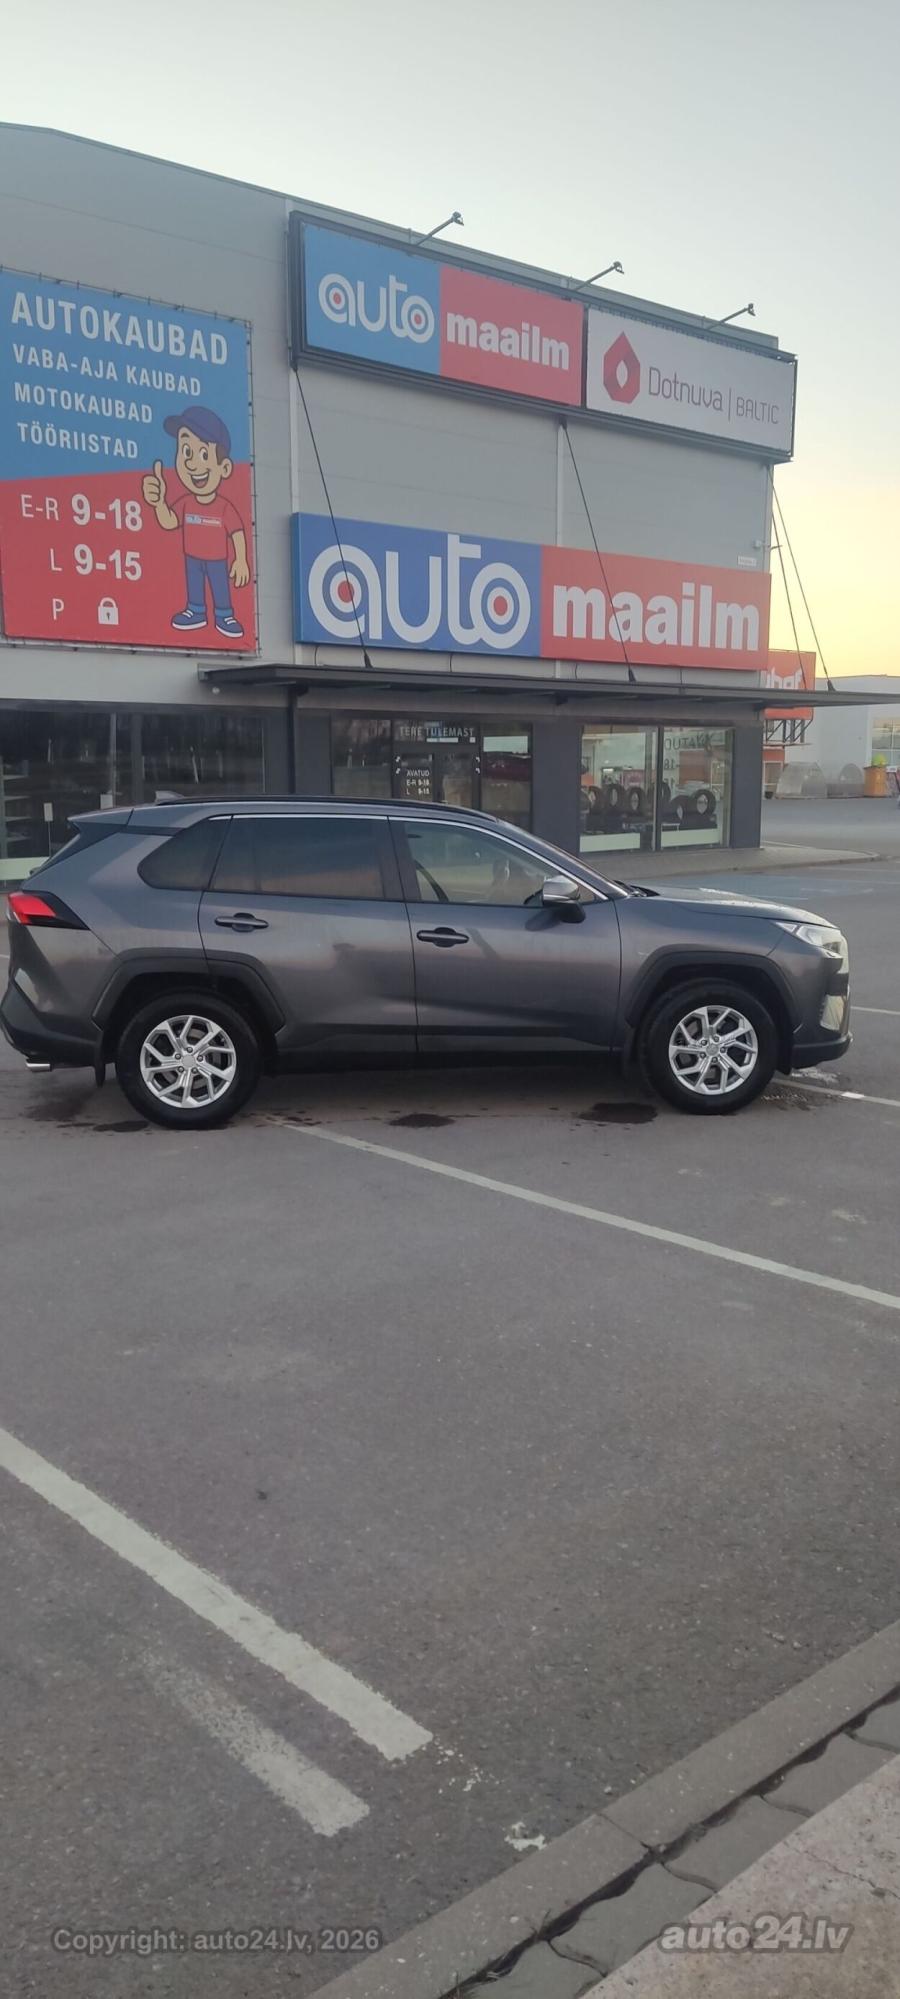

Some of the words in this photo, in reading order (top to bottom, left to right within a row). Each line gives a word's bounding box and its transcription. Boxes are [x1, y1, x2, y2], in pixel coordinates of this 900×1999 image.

[11, 292, 228, 366] AUTOKAUBAD
[318, 273, 435, 344] auto
[446, 311, 570, 371] maailm
[13, 344, 118, 382] VABA-AJA
[126, 365, 201, 396] KAUBAD
[14, 383, 153, 424] MOTOKAUBAD
[648, 366, 723, 413] Dotnuva
[736, 395, 780, 425] BALTIC
[17, 422, 139, 459] TÖÖRIISTAD
[21, 494, 59, 520] E-R
[71, 493, 143, 531] 9-18
[50, 548, 62, 571] L
[74, 544, 143, 581] 9-15
[52, 598, 64, 620] P
[308, 534, 531, 649] auto
[553, 582, 760, 652] maailm
[400, 726, 423, 736] TERE
[425, 727, 474, 737] TULEMAST
[406, 769, 430, 777] AVATUD
